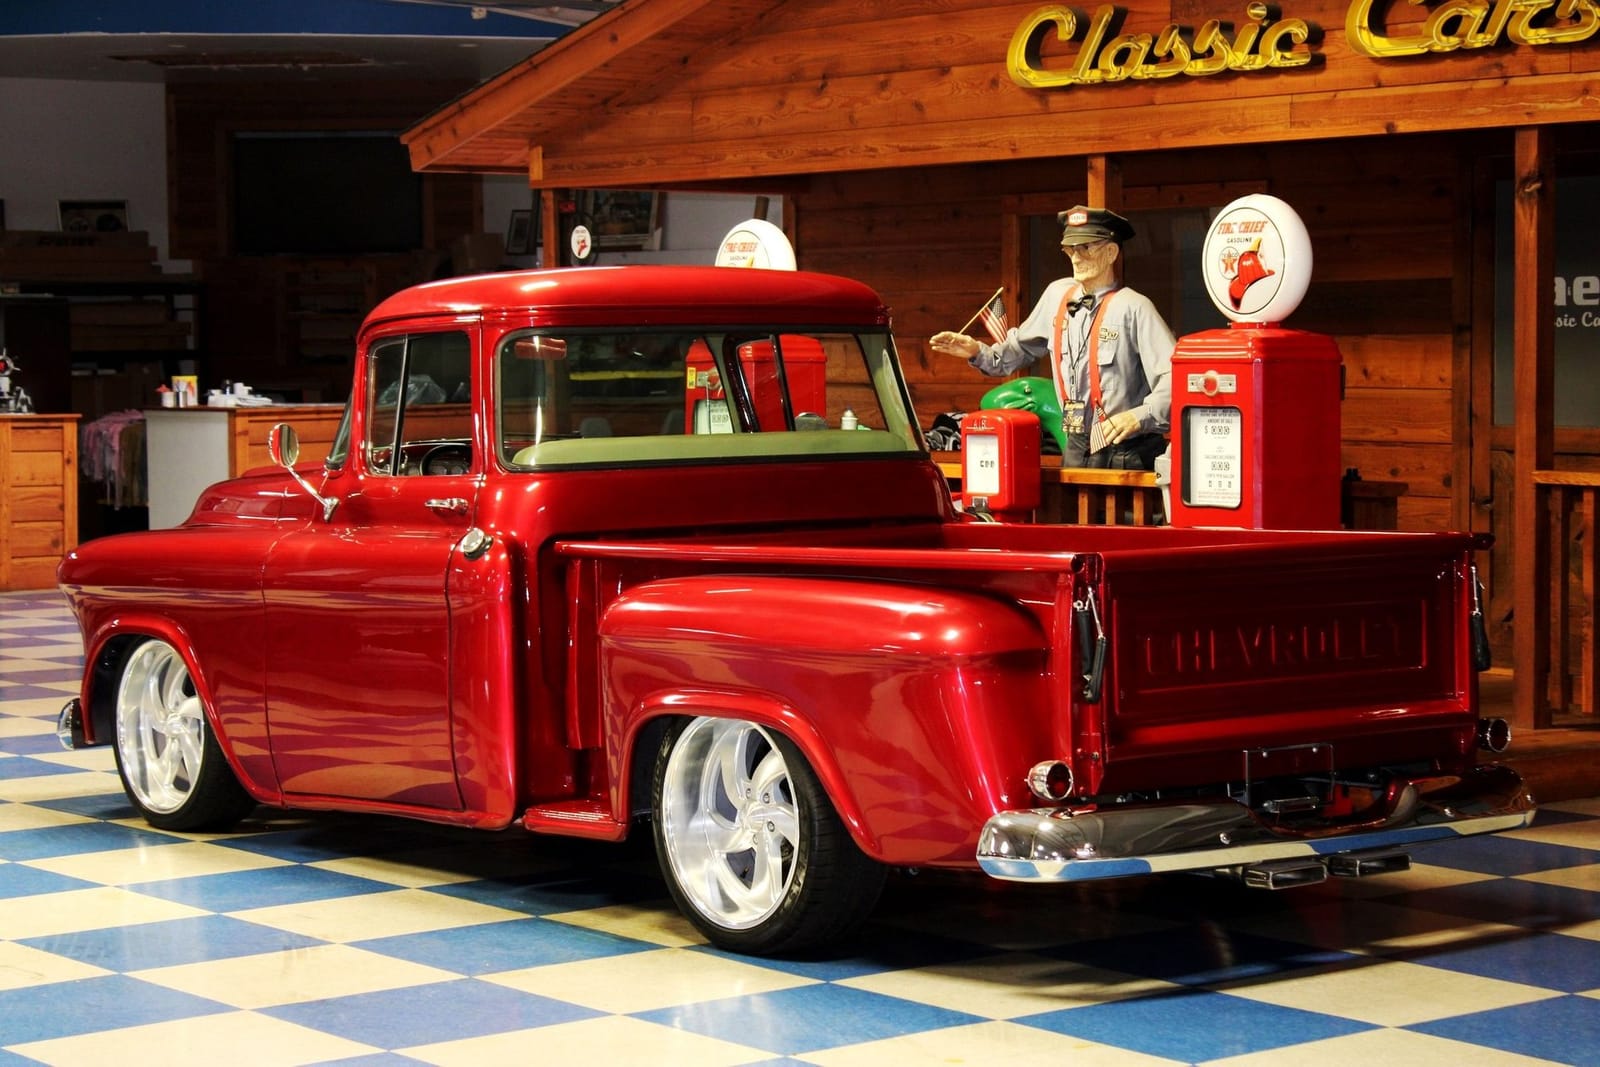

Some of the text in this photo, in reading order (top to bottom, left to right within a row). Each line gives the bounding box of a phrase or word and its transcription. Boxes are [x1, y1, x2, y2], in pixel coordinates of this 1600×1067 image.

[1007, 0, 1600, 88] Classic Cars
[1554, 313, 1577, 327] sic
